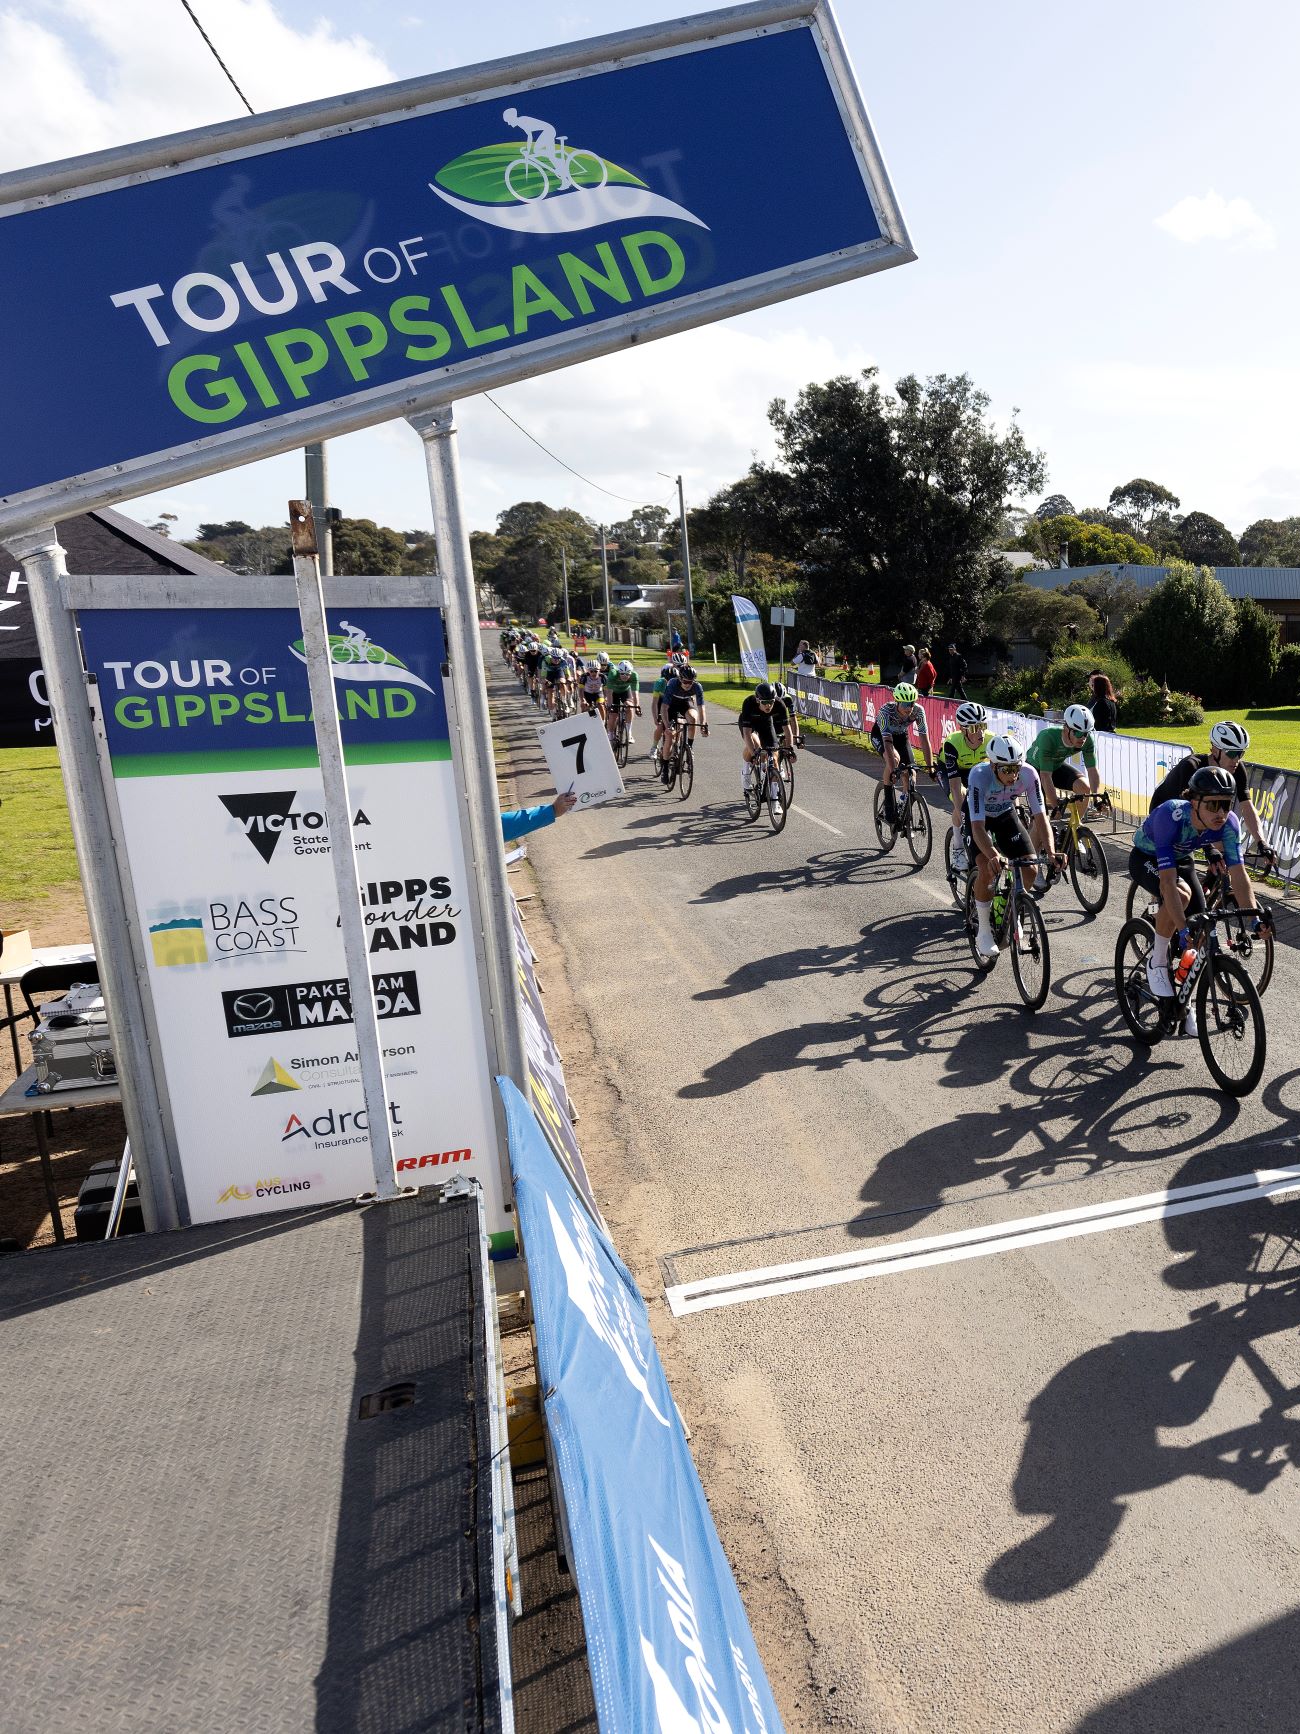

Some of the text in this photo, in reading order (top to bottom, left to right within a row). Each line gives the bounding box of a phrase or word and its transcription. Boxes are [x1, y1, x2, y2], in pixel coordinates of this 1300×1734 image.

[110, 237, 430, 347] TOUR OF
[168, 230, 687, 425] GIPPSLAND
[103, 659, 276, 690] TOUR OF
[560, 733, 587, 775] 7
[235, 809, 371, 834] VICTOA
[293, 835, 329, 845] State
[294, 841, 373, 855] Goverent
[360, 876, 452, 906] IPPS
[209, 897, 298, 931] BASS
[336, 897, 462, 928] onder
[215, 926, 300, 952] COAST
[369, 921, 457, 954] AND
[296, 976, 404, 1000] PAKEAM
[298, 991, 416, 1025] MADA
[290, 1045, 416, 1070] Simon Arson
[300, 1065, 361, 1081] Consulta
[281, 1101, 403, 1142] Adrot
[314, 1134, 369, 1150] Insurance
[397, 1148, 472, 1171] RAM
[255, 1181, 311, 1198] CYCLING
[256, 1177, 281, 1189] AUS
